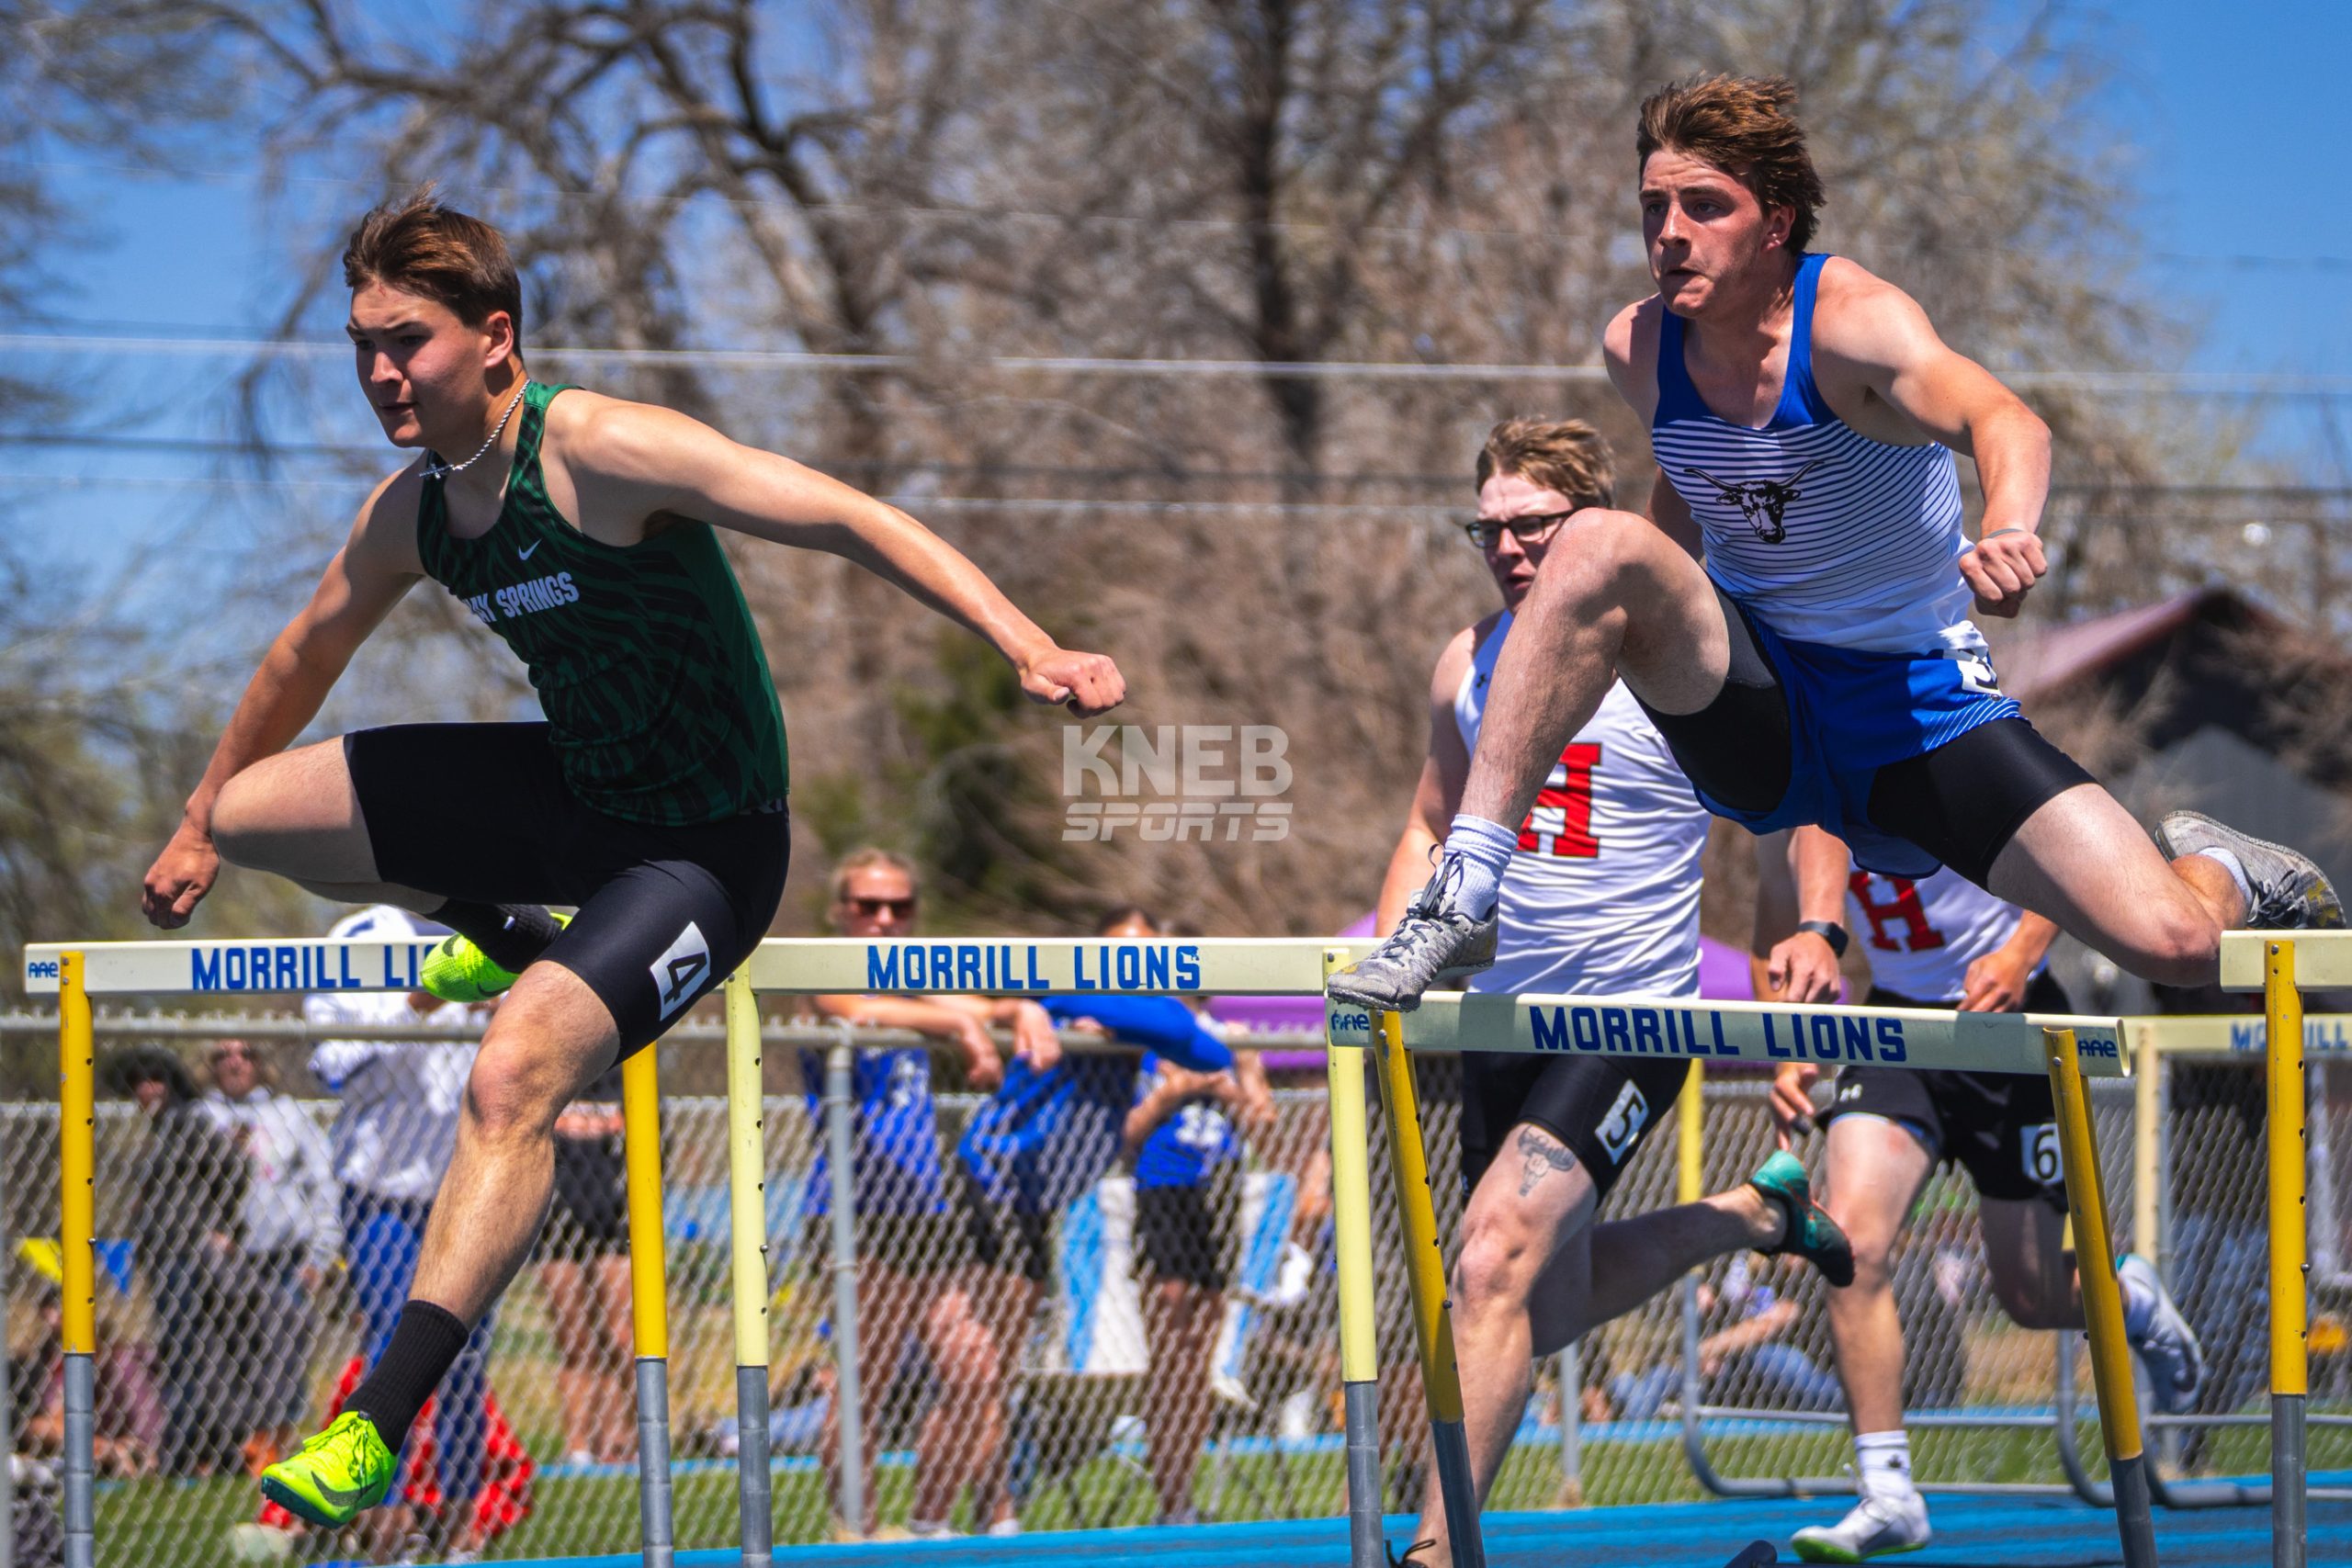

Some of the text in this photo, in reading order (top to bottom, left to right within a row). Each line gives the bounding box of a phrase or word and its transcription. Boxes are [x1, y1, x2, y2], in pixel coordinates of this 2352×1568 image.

[495, 571, 580, 618] SPRINGS
[1516, 742, 1602, 858] H
[1849, 870, 1945, 952] H
[191, 946, 361, 990] MORRILL
[663, 952, 707, 1005] 4
[866, 944, 1201, 990] MORRILL LIONS
[1529, 1005, 1907, 1063] MORRILL LIONS
[1606, 1091, 1644, 1149] 5
[2031, 1129, 2057, 1179] 6
